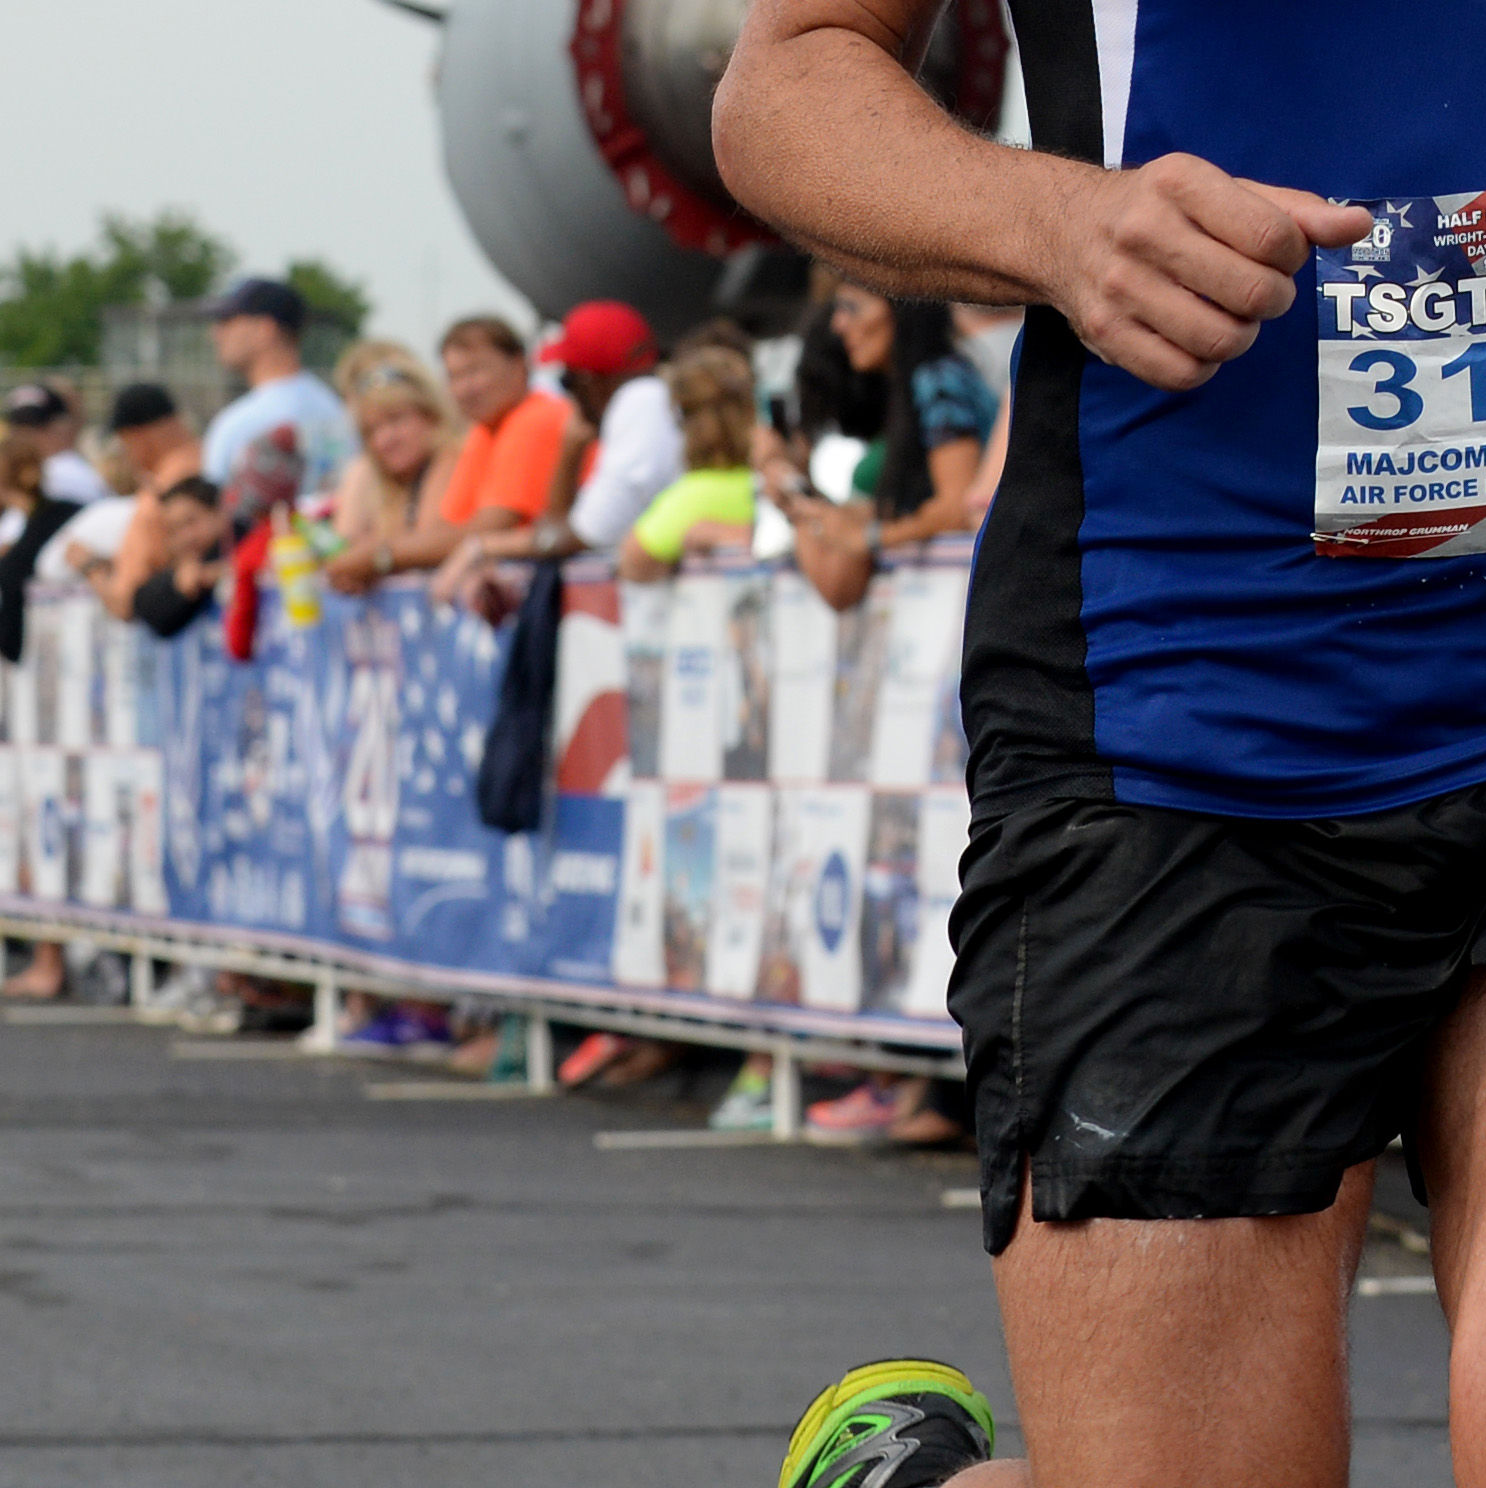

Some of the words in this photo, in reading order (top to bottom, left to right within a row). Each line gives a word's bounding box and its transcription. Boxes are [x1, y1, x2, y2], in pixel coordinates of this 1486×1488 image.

[1437, 210, 1481, 229] HALF
[1340, 485, 1386, 504] AIR
[1394, 478, 1478, 504] FORCE
[1344, 527, 1408, 537] NORTHROP
[1409, 523, 1469, 536] GRUMMAN
